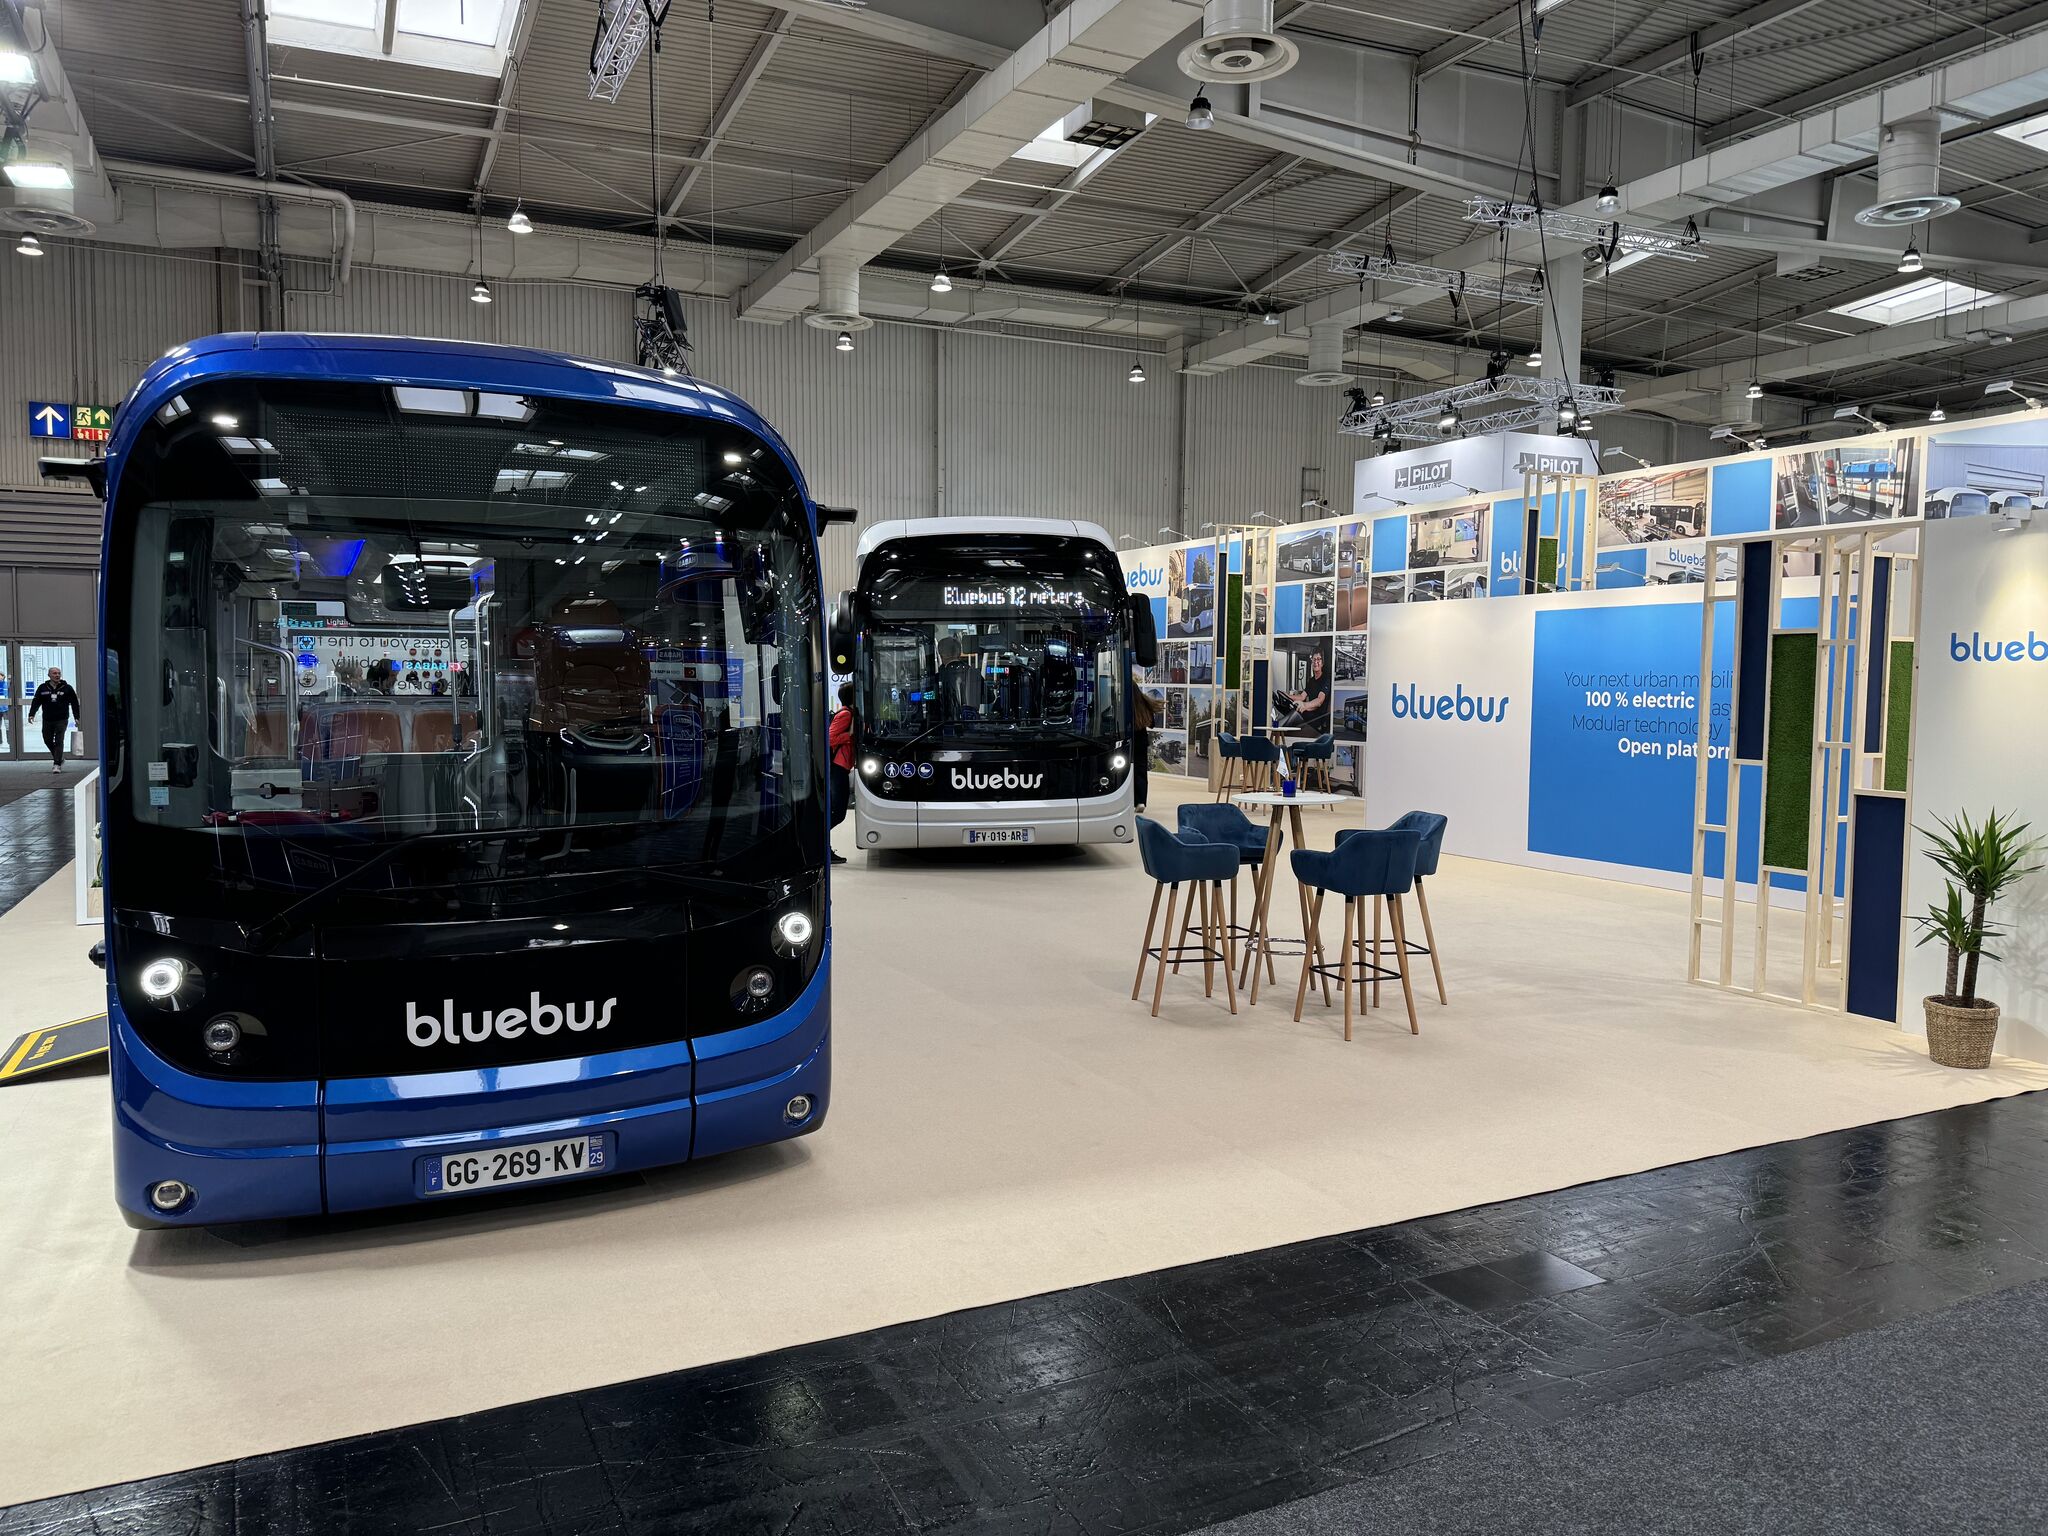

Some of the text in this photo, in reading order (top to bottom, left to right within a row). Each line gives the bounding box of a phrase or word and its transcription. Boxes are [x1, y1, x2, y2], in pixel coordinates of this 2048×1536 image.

[944, 587, 1005, 605] Bluebus
[1950, 631, 2048, 662] blueb
[1564, 671, 1734, 688] Your next urban mbili
[1391, 683, 1509, 723] bluebus
[1585, 691, 1695, 709] 100 % electric
[1572, 714, 1723, 741] Modular technoloy
[1618, 737, 1731, 760] Open plator
[951, 767, 1044, 790] bluebus
[406, 991, 617, 1047] bluebus
[446, 1142, 585, 1187] GG-269-KV
[590, 1151, 604, 1166] 29
